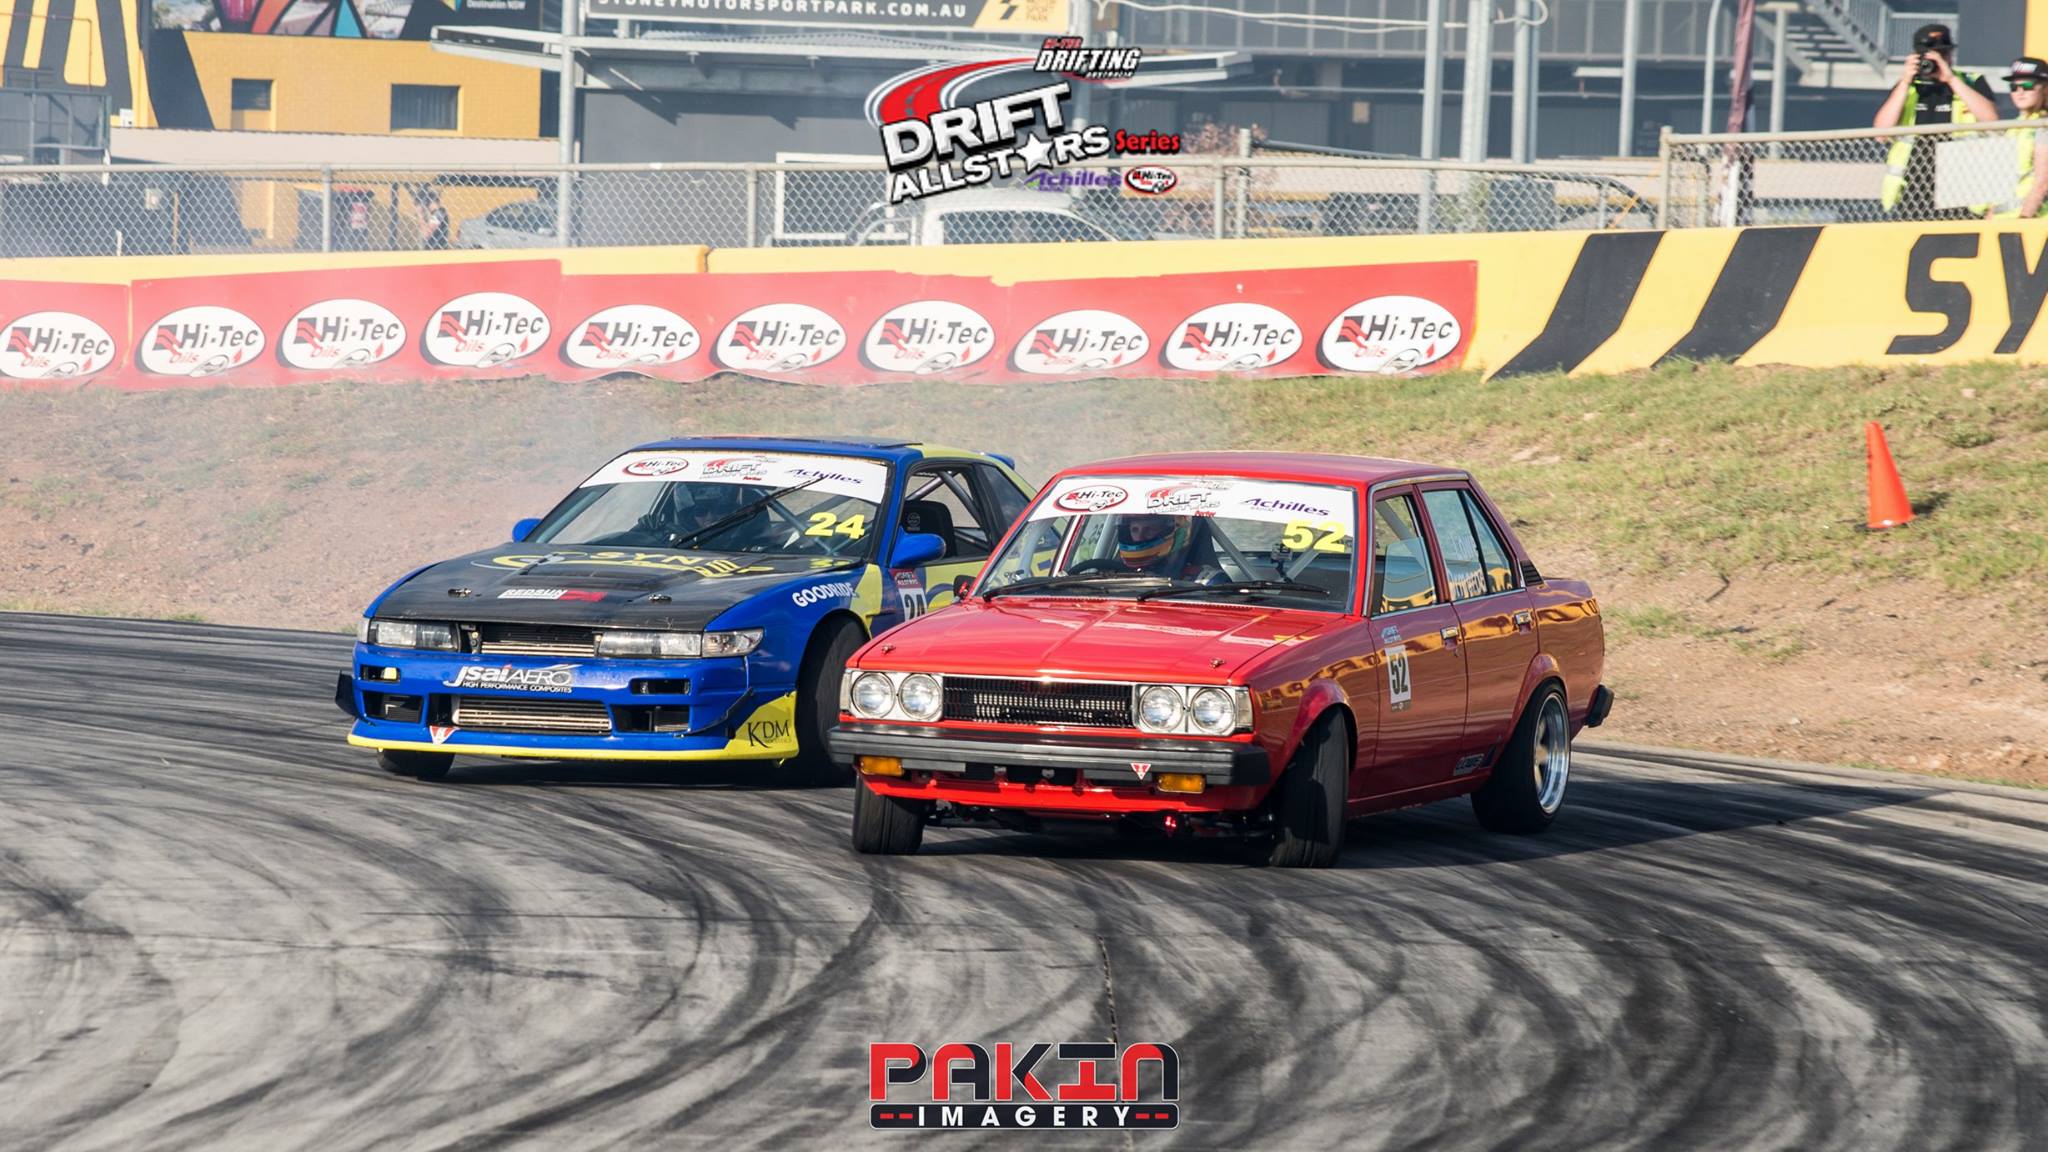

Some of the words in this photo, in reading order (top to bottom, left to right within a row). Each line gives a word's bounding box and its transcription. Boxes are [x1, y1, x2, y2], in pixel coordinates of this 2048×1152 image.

[1885, 232, 2048, 354] SY
[181, 323, 259, 348] Hi-Tec
[321, 316, 399, 342] Hi-Tec
[465, 310, 544, 336] Hi-Tec
[610, 322, 694, 347] Hi-Tec
[759, 321, 840, 346] Hi-Tec
[907, 318, 988, 344] Hi-Tec
[1210, 321, 1295, 347] Hi-Tec
[1367, 314, 1453, 341] Hi-Tec
[32, 328, 109, 355] Hi-Tec
[1058, 328, 1142, 352] Hi-Tec
[786, 468, 863, 484] Achilles
[1147, 491, 1212, 509] DRIFT
[1243, 498, 1331, 516] Achilles
[804, 512, 865, 539] 24
[1282, 518, 1345, 553] 52
[503, 588, 568, 598] REDSUN
[792, 582, 858, 607] GOODRIDE
[1389, 653, 1409, 695] 52
[480, 682, 528, 691] PERFORMANCE
[530, 685, 573, 693] COMPOSITES
[747, 719, 790, 748] KDM
